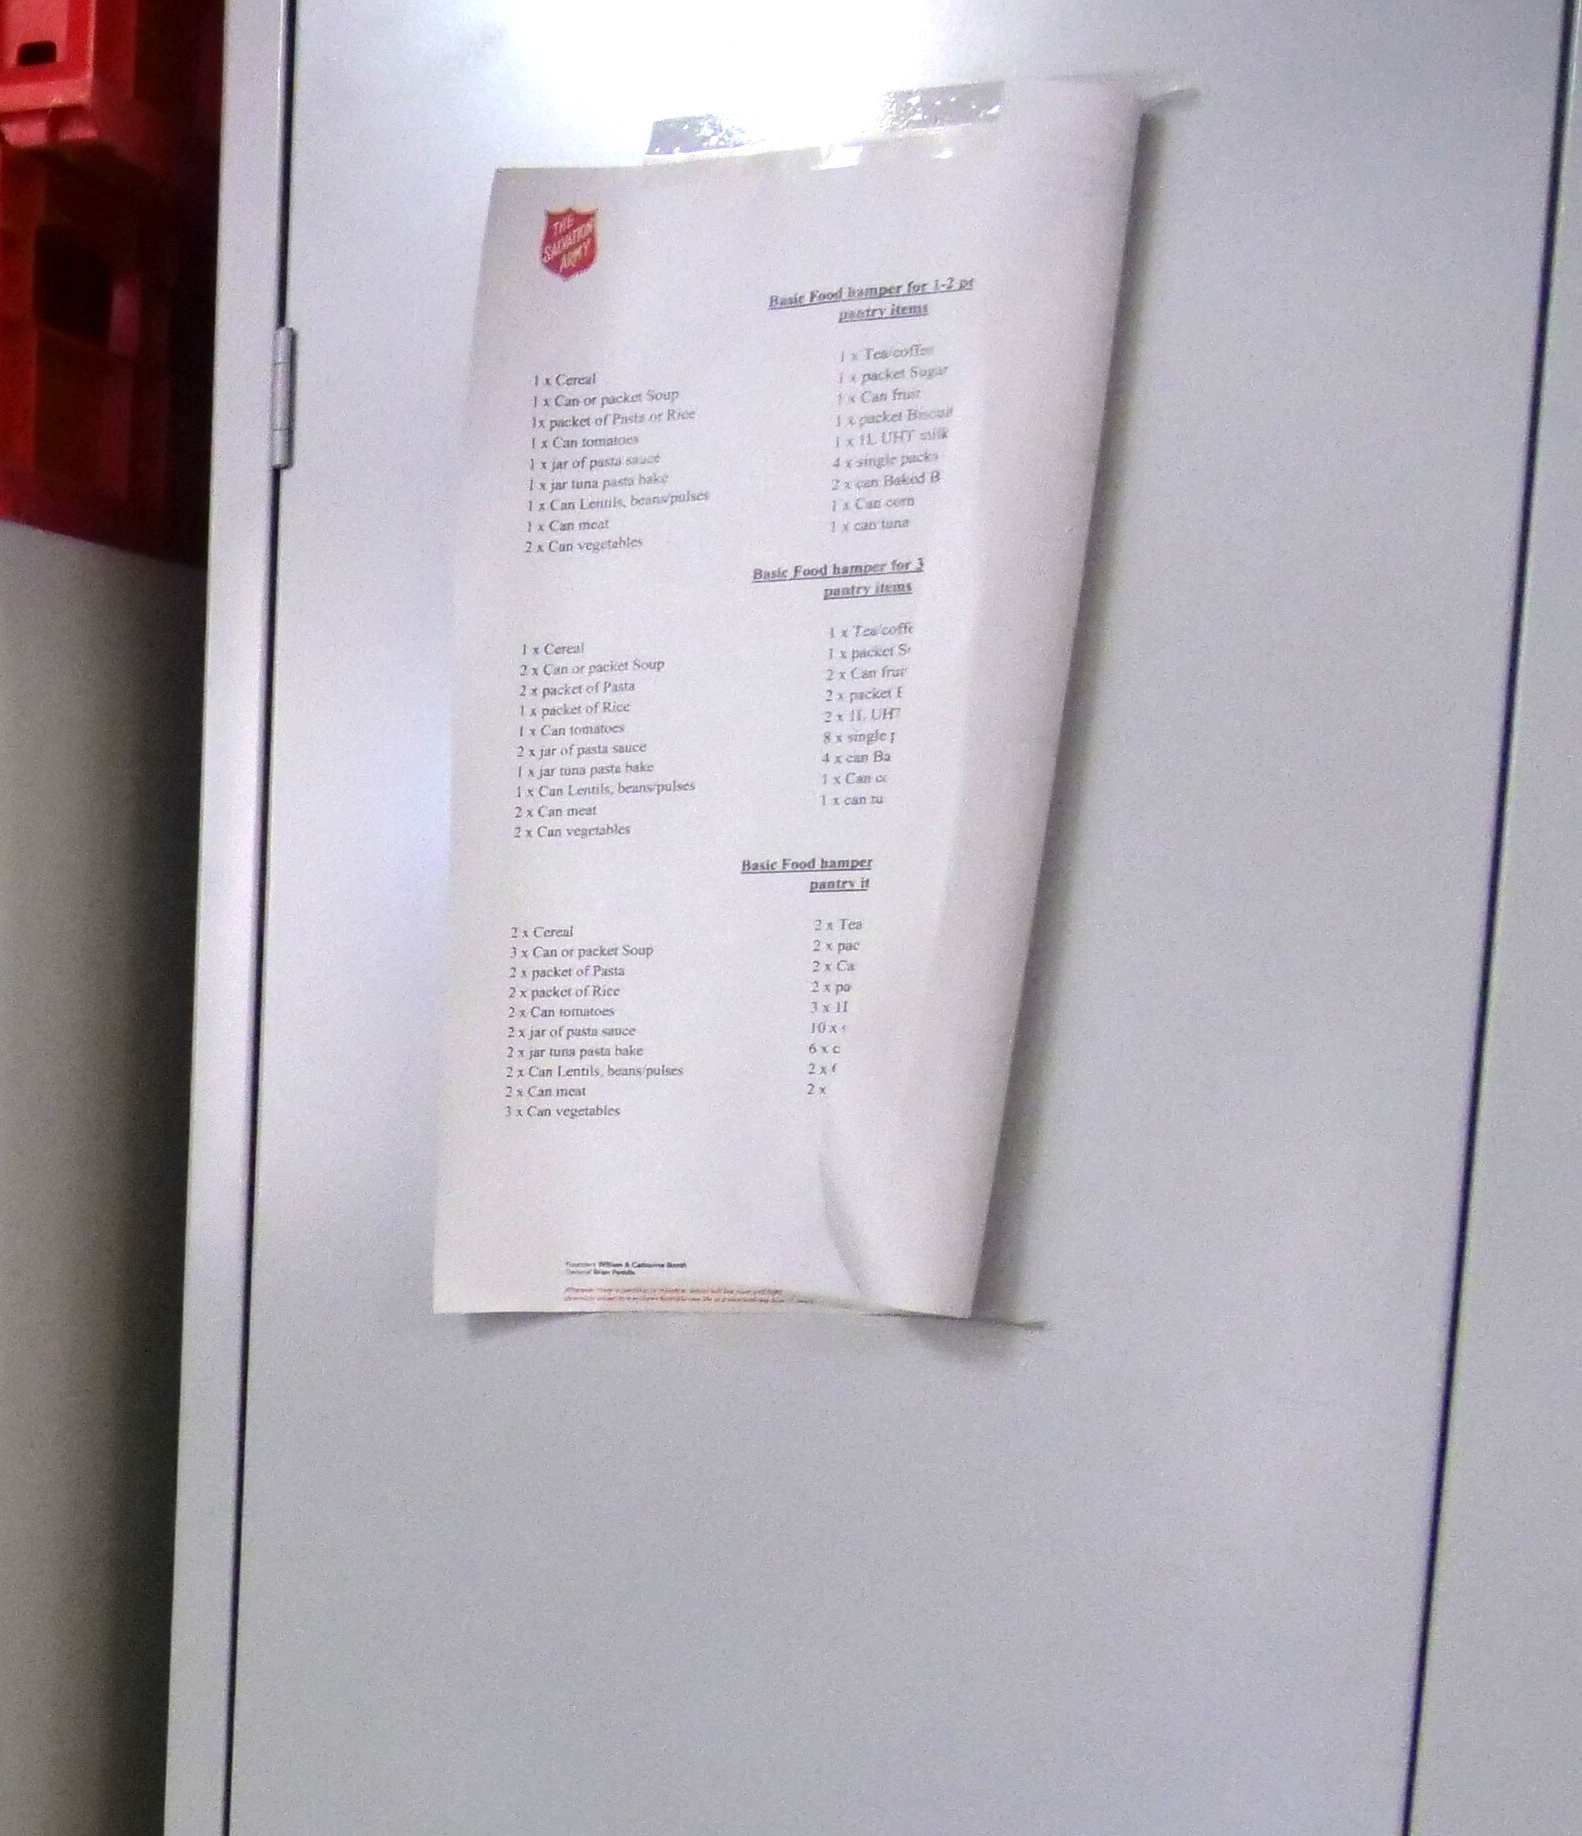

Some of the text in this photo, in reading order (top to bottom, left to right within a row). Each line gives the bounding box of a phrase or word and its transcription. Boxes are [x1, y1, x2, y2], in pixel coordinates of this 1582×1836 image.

[553, 214, 574, 236] THE
[544, 221, 592, 263] SALVATION
[560, 238, 591, 272] ARMY
[769, 295, 803, 309] Basic
[810, 288, 842, 304] Food
[848, 281, 903, 300] hamper
[907, 281, 927, 294] for
[838, 303, 928, 322] pantry items
[753, 567, 788, 582] Basic
[793, 565, 827, 580] Food
[833, 561, 886, 578] hamper
[891, 559, 911, 572] for
[823, 583, 912, 599] pantry items
[544, 643, 584, 655] Cereal
[520, 665, 527, 676] 2
[543, 664, 568, 675] Can
[572, 665, 584, 673] or
[589, 662, 628, 675] packet
[633, 659, 665, 672] Soup
[520, 685, 526, 696] 2
[542, 685, 582, 698] packet
[587, 682, 599, 694] of
[604, 682, 635, 692] Pasta
[542, 704, 582, 718] packet
[586, 703, 599, 713] of
[603, 703, 630, 713] Rice
[541, 725, 565, 736] Can
[570, 724, 625, 735] tomatoes
[539, 786, 563, 797] Can
[514, 807, 522, 818] 2
[538, 806, 562, 817] Can
[567, 806, 597, 816] meat
[514, 827, 521, 838] 2
[537, 826, 562, 837] Can
[567, 824, 631, 839] vegetables
[741, 858, 873, 873] Basic Food hamper
[810, 879, 855, 892] pantry
[511, 927, 518, 938] 2
[534, 926, 573, 938] Cereal
[510, 947, 517, 958] 3
[533, 947, 557, 957] Can
[561, 948, 574, 957] or
[578, 946, 618, 960] packet
[623, 945, 654, 958] Soup
[510, 967, 516, 978] 2
[532, 968, 572, 981] packet
[576, 966, 589, 976] of
[594, 965, 625, 976] Pasta
[508, 987, 516, 998] 2
[531, 987, 571, 1001] packet
[576, 986, 589, 996] of
[593, 986, 620, 996] Rice
[508, 1007, 516, 1018] 2
[531, 1007, 555, 1017] Can
[560, 1006, 615, 1017] tomatoes
[508, 1027, 515, 1038] 2
[529, 1026, 546, 1040] jar
[550, 1026, 563, 1037] of
[567, 1027, 598, 1040] pasta
[602, 1027, 636, 1036] sauce
[507, 1047, 514, 1058] 2
[529, 1047, 546, 1059] jar
[550, 1047, 575, 1057] tuna
[580, 1047, 611, 1059] pasta
[616, 1045, 643, 1056] bake
[507, 1067, 513, 1077] 2
[529, 1066, 553, 1077] Can
[505, 1086, 512, 1097] 2
[528, 1086, 552, 1097] Can
[556, 1086, 586, 1097] meat
[505, 1106, 511, 1117] 3
[527, 1106, 551, 1116] Can
[556, 1104, 620, 1119] vegetables
